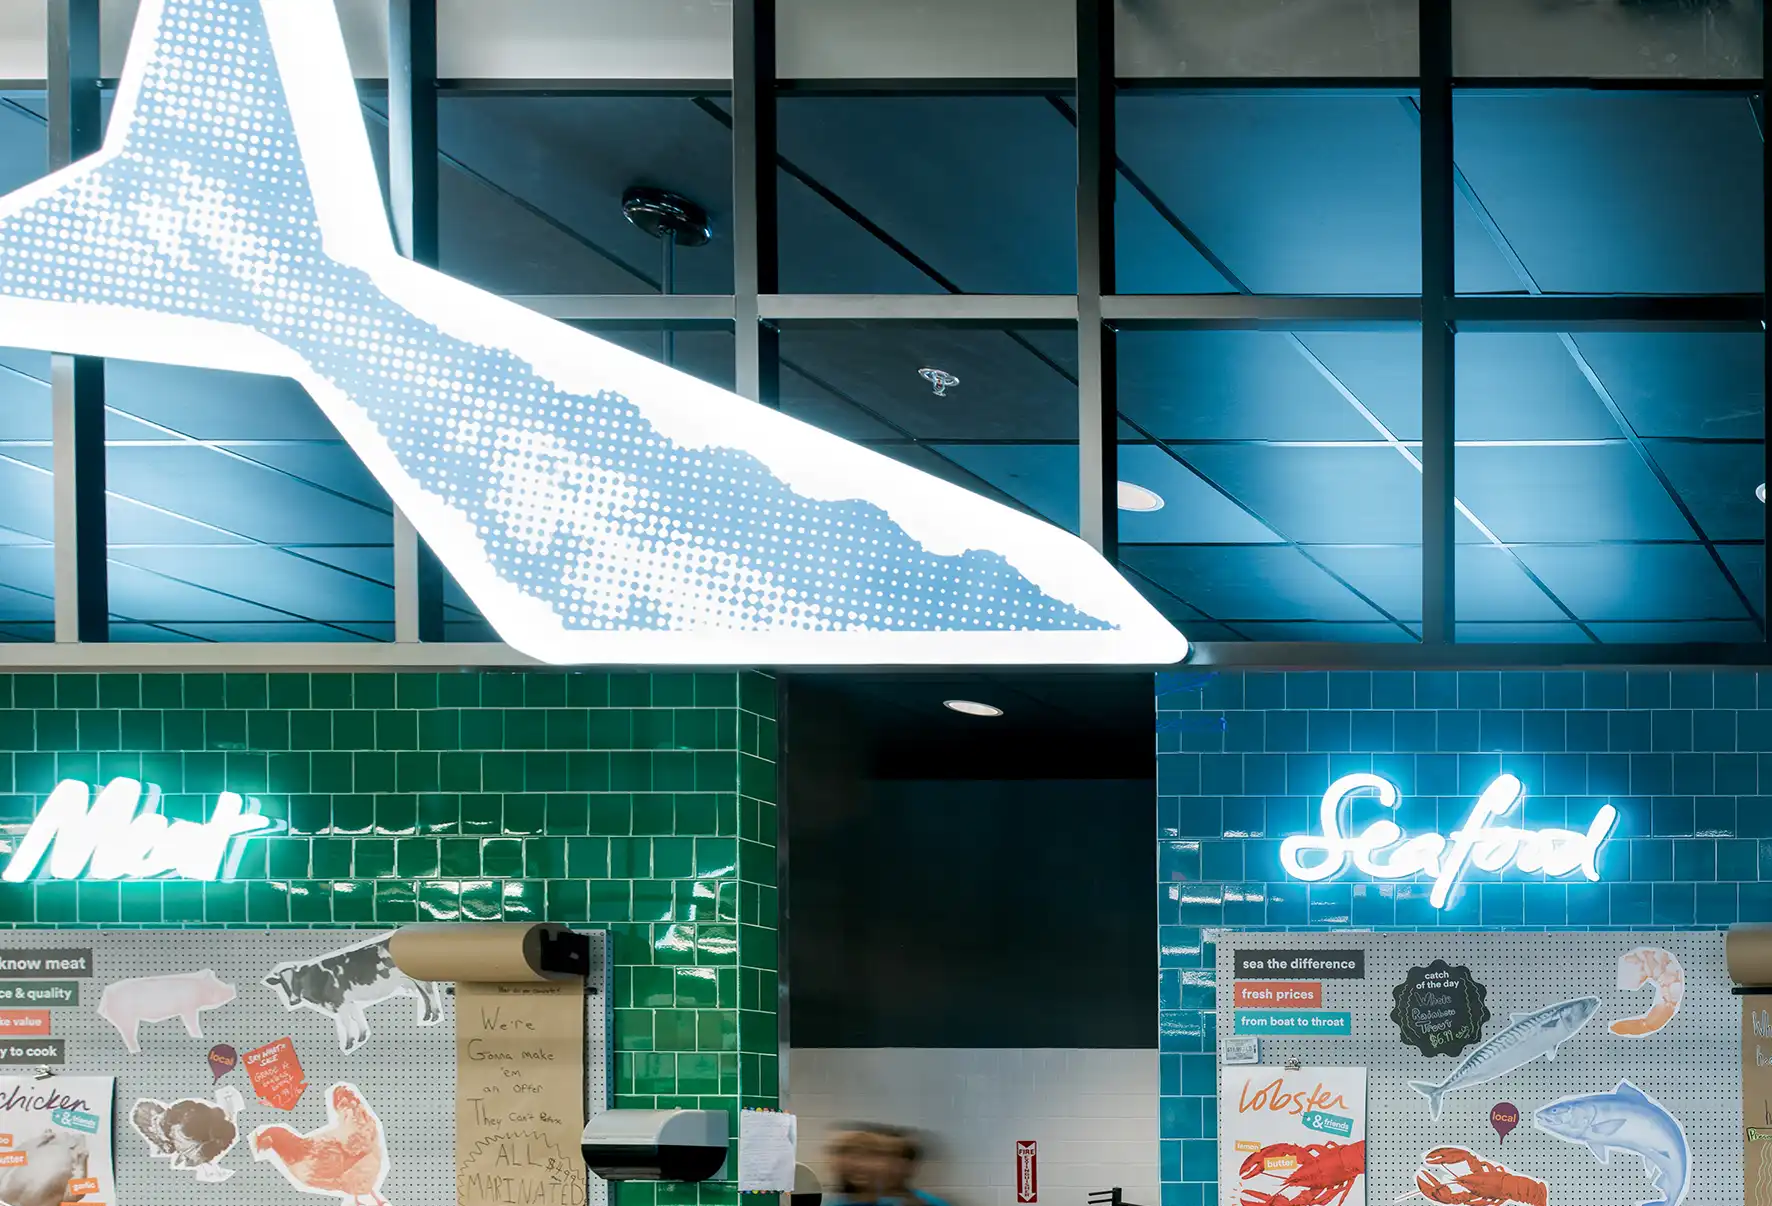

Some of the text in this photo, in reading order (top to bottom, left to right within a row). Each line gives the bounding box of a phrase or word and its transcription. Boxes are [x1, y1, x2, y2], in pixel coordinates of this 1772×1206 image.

[1280, 773, 1616, 908] Seafood
[45, 957, 86, 970] meat
[1243, 958, 1356, 970] sea the difference
[1425, 971, 1450, 980] catch
[1416, 980, 1460, 990] of the day
[15, 987, 72, 1001] & quality
[1241, 988, 1314, 1001] fresh prices
[13, 1017, 42, 1027] value
[1241, 1016, 1345, 1027] from boat to throat
[10, 1045, 57, 1057] to cook
[521, 1048, 555, 1061] make
[210, 1050, 236, 1066] local
[483, 1086, 500, 1094] an
[61, 1111, 72, 1126] &
[467, 1098, 503, 1130] They
[1492, 1111, 1517, 1123] local
[1312, 1114, 1349, 1130] & friends
[1237, 1143, 1260, 1151] lemon
[0, 1154, 24, 1164] utter
[495, 1143, 543, 1167] ALL
[1266, 1158, 1296, 1168] butter
[467, 1172, 585, 1206] MARINATED
